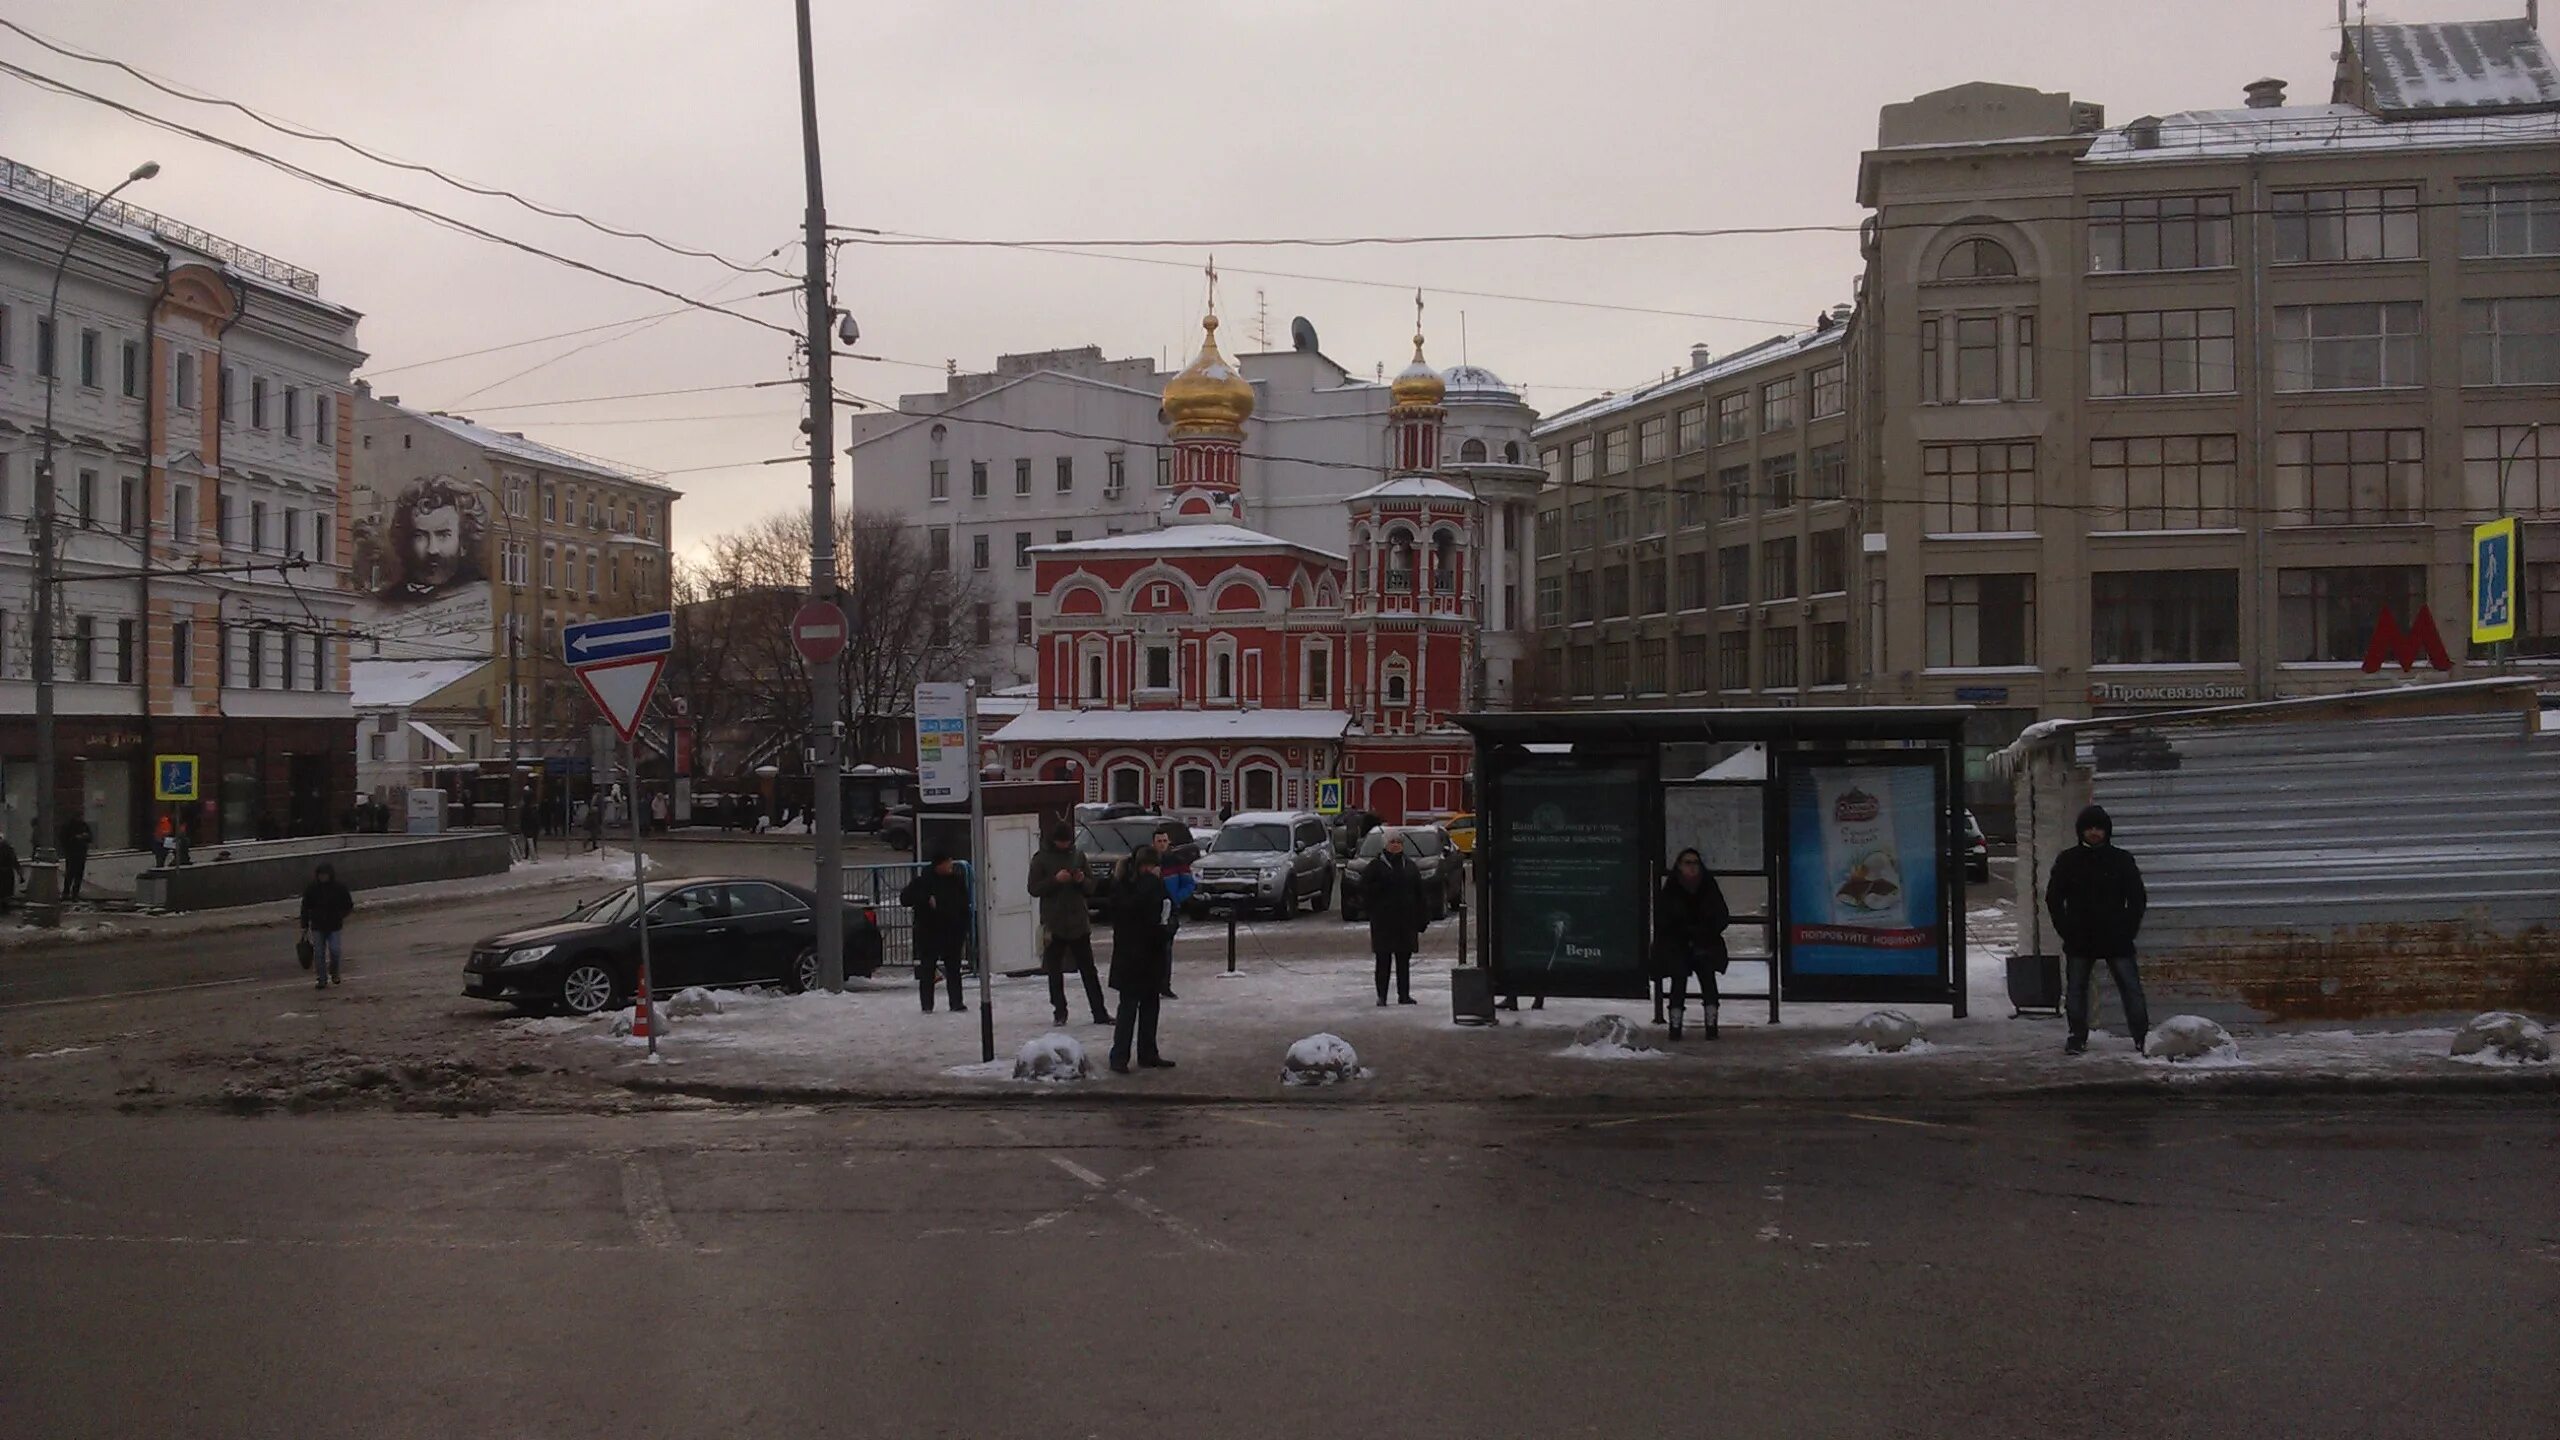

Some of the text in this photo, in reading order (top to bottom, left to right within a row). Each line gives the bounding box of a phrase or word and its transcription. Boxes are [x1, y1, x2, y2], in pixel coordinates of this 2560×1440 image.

[2361, 602, 2453, 673] М
[2112, 683, 2246, 702] Промсвязьбанк
[1801, 930, 1868, 944] ПОПРОБУЙТЕ
[1565, 943, 1601, 958] Вера
